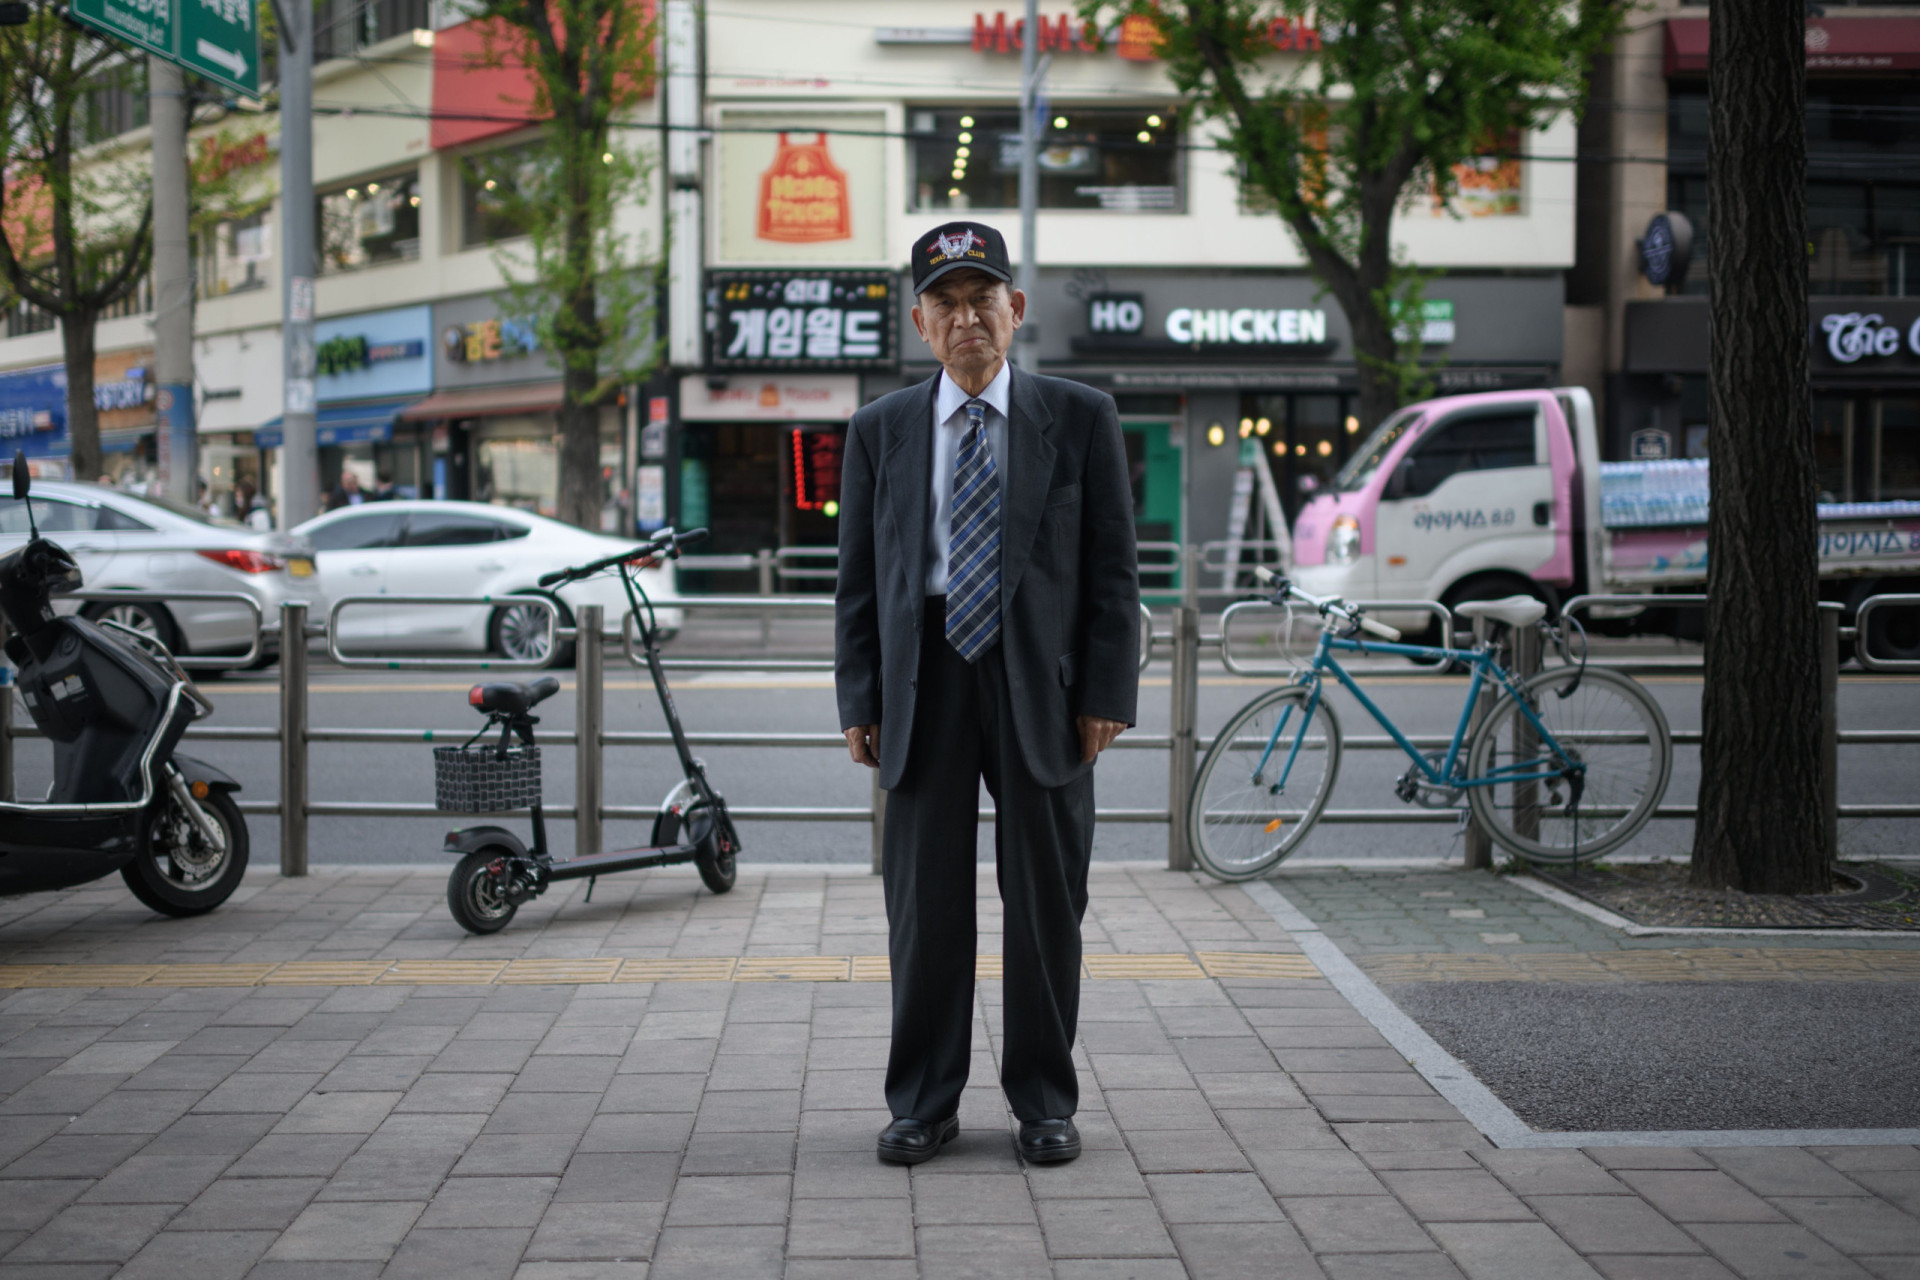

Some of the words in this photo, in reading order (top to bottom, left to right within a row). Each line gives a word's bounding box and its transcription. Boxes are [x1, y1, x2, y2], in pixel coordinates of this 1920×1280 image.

[929, 253, 946, 265] TEXAS
[967, 249, 986, 259] CLUB
[727, 307, 881, 357] 게임월드
[1091, 301, 1143, 331] HO
[1166, 308, 1326, 343] CHICKEN
[1821, 312, 1900, 362] The
